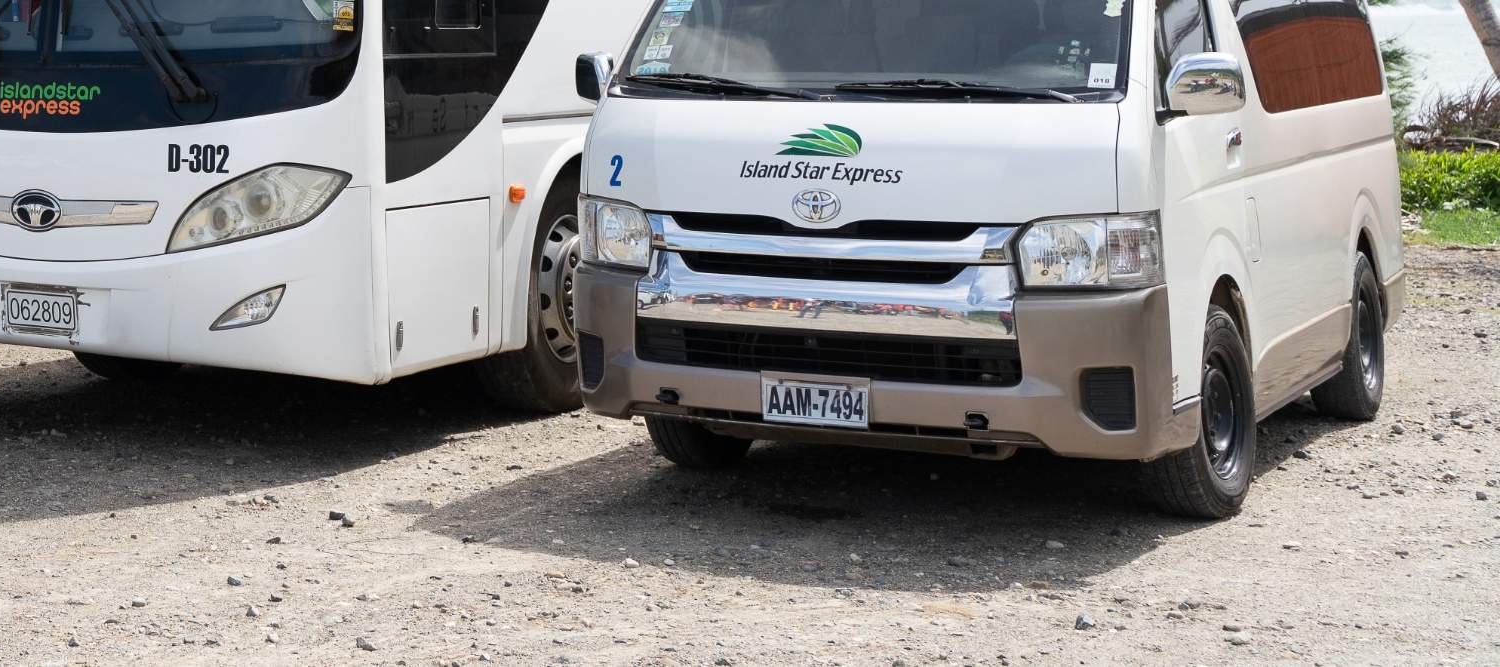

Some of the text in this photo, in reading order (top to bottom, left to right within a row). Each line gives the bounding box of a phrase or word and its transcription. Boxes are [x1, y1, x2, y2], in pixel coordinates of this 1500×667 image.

[0, 82, 100, 100] islandstar
[0, 99, 81, 119] express
[167, 143, 230, 174] D-302
[610, 154, 623, 187] 2
[739, 160, 903, 186] Island Star Express
[10, 298, 72, 324] 062809
[768, 386, 864, 420] AAM-7494
